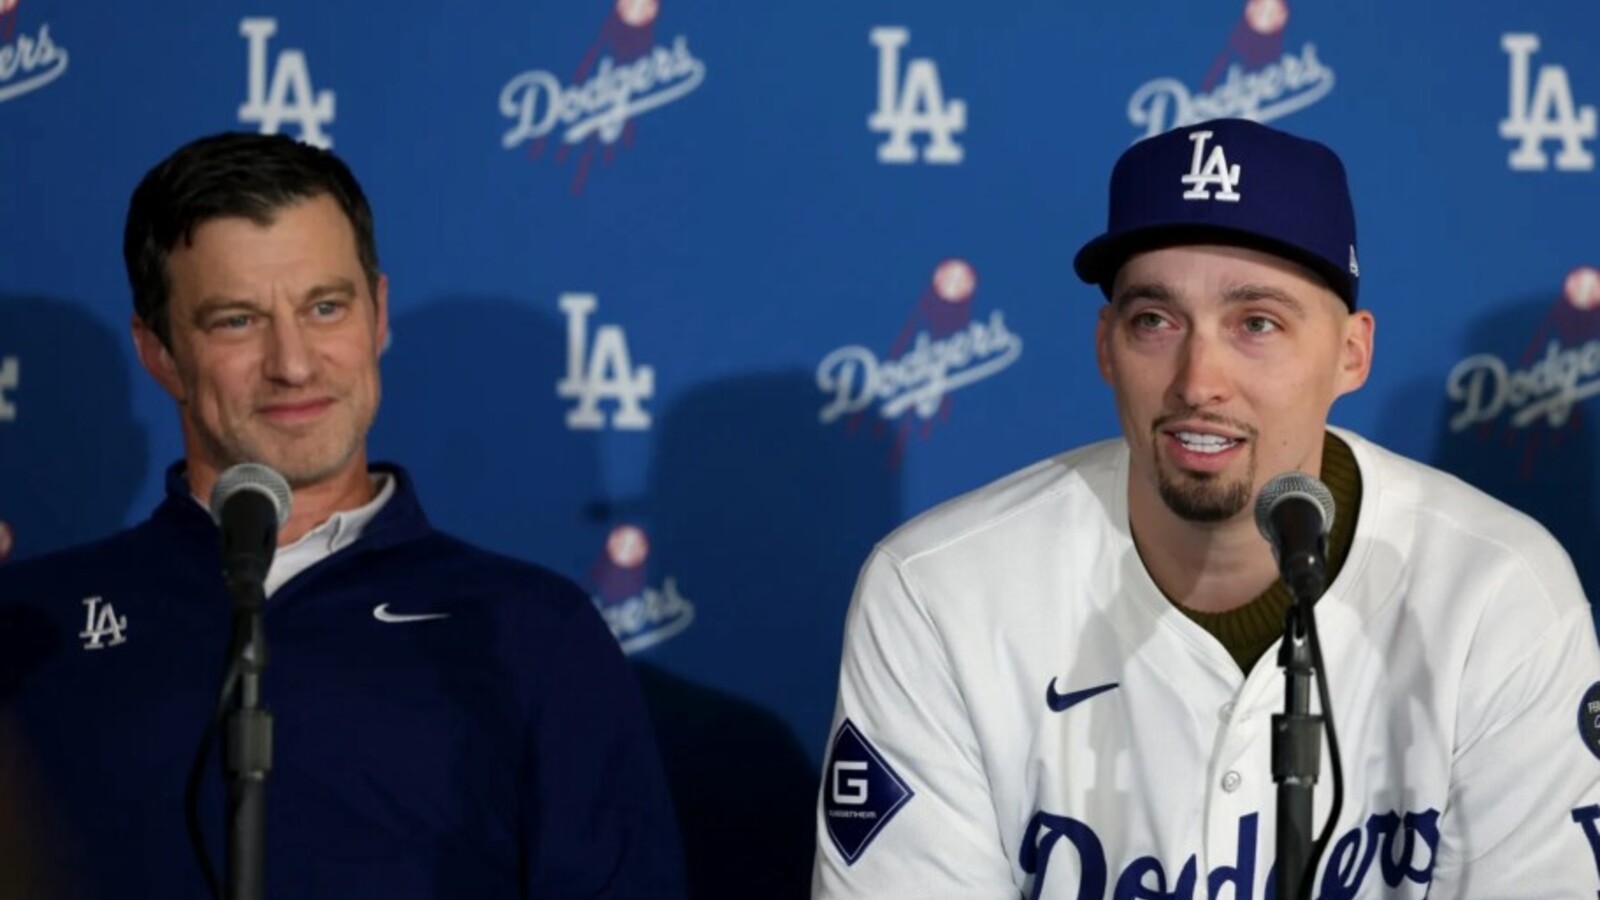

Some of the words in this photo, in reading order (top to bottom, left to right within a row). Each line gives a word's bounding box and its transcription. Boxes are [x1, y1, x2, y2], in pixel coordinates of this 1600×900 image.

[239, 18, 335, 149] LA
[499, 36, 706, 148] Dodgers
[869, 27, 966, 163] LA
[1499, 33, 1596, 170] LA
[1181, 131, 1241, 202] LA
[556, 293, 654, 430] LA
[816, 311, 1022, 424] Dodgers
[1446, 338, 1600, 433] Dodge
[79, 596, 127, 650] LA
[832, 760, 868, 804] G
[1019, 808, 1441, 900] Doders
